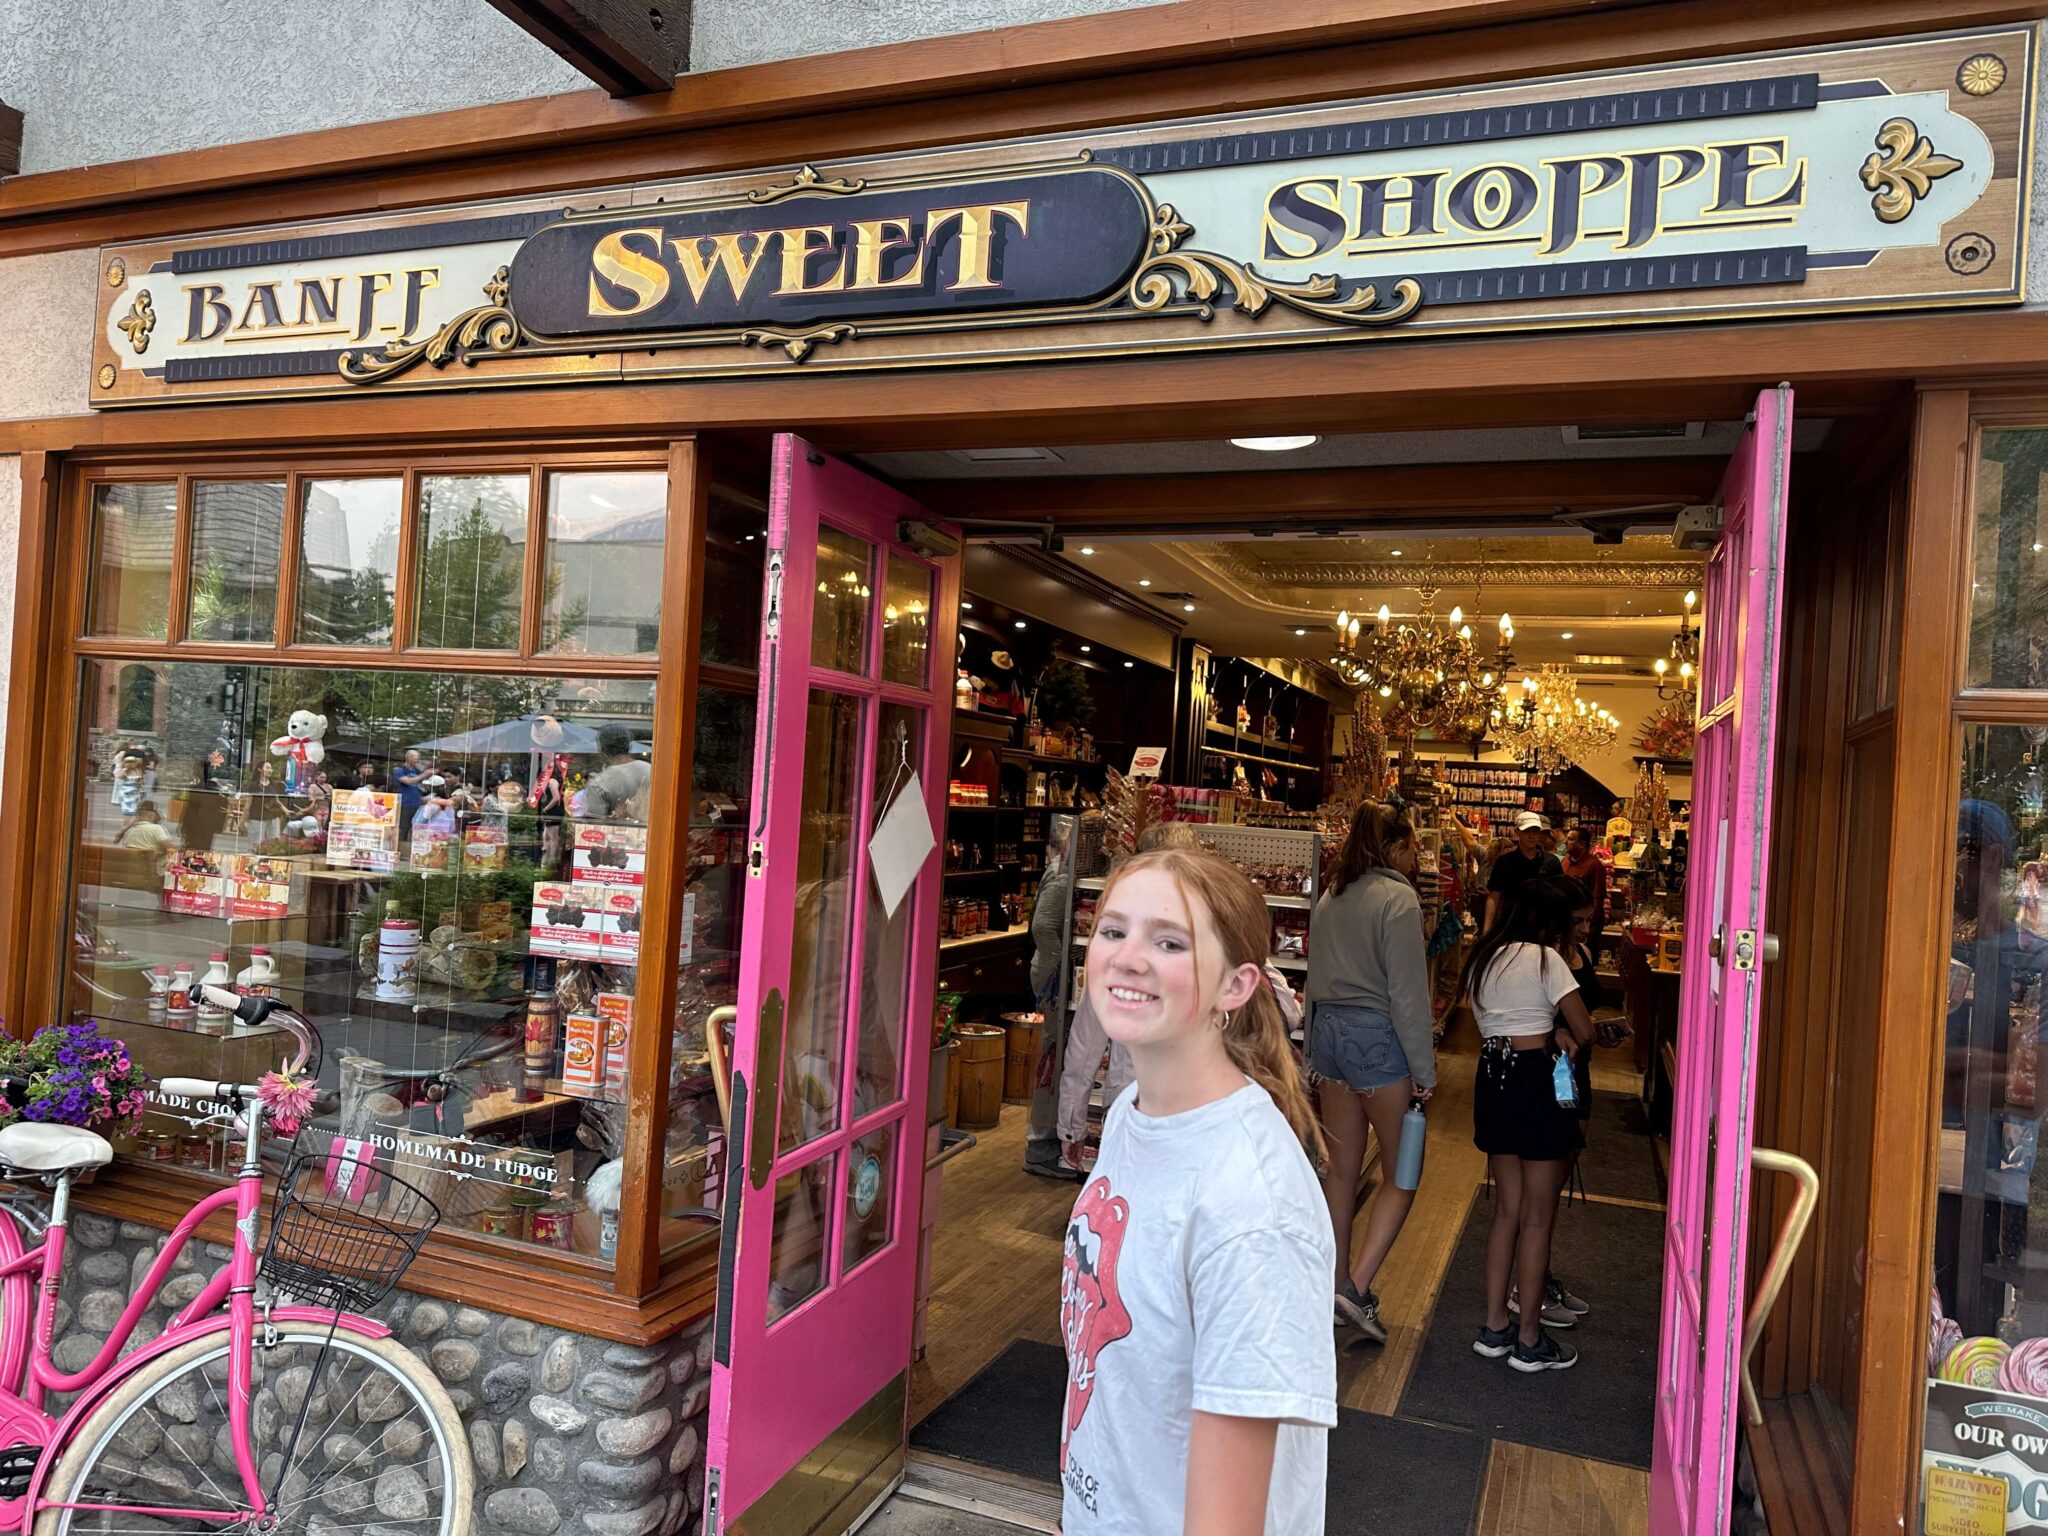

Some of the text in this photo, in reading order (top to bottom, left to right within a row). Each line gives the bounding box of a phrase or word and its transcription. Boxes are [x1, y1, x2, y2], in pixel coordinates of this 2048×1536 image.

[177, 135, 1808, 345] BANFF SWEET SHOPPE
[196, 1099, 236, 1115] CHO
[369, 1133, 558, 1183] HOMEMADE FUDGE
[1982, 1405, 2041, 1423] WE MAKE
[1954, 1422, 2005, 1448] OUR
[1065, 1469, 1098, 1518] AMERICA
[1085, 1475, 1099, 1494] OF
[1934, 1474, 2003, 1497] WARNING
[1931, 1520, 1998, 1536] SURVEILLANC
[1951, 1516, 1980, 1529] VIDEO
